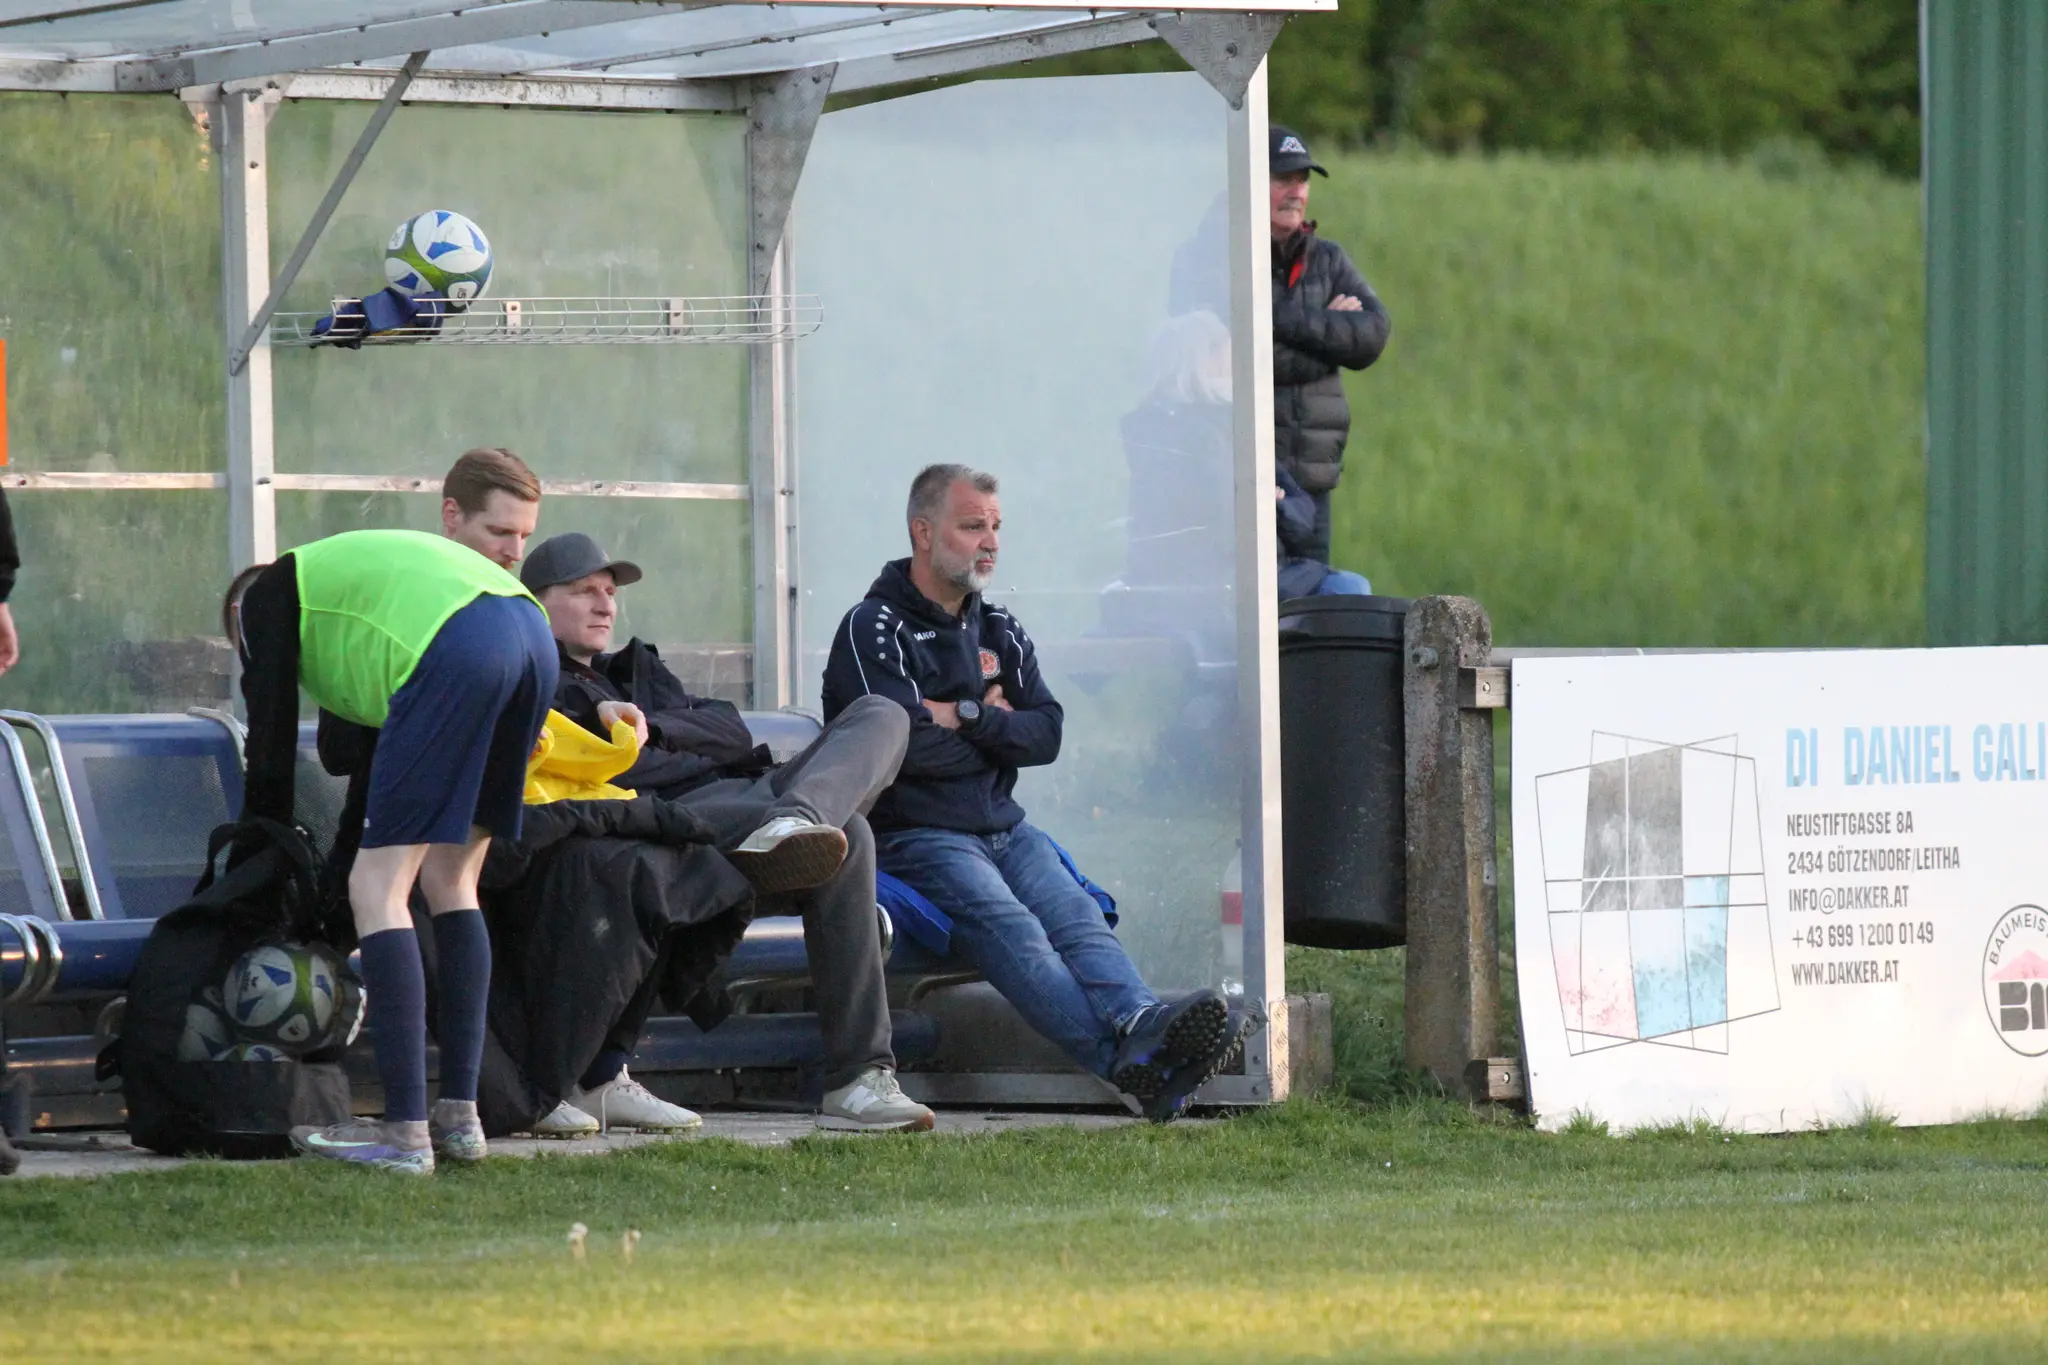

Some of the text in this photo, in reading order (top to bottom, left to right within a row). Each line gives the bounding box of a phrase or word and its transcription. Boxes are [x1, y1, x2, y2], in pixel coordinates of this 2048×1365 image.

[1786, 728, 1818, 787] DI
[1844, 725, 1961, 786] DANIEL
[1787, 811, 1914, 837] NEUSTIFTGASSE 8A
[1788, 845, 1960, 874] 2434 GÖTZENDORF/LEITHA
[1789, 885, 1909, 915] INFO@DAKKER.AT
[1792, 921, 1934, 948] +43 699 1200 0149
[1989, 913, 2048, 966] BAUMEIS
[1791, 960, 1899, 986] WWW.DAKKER.AT
